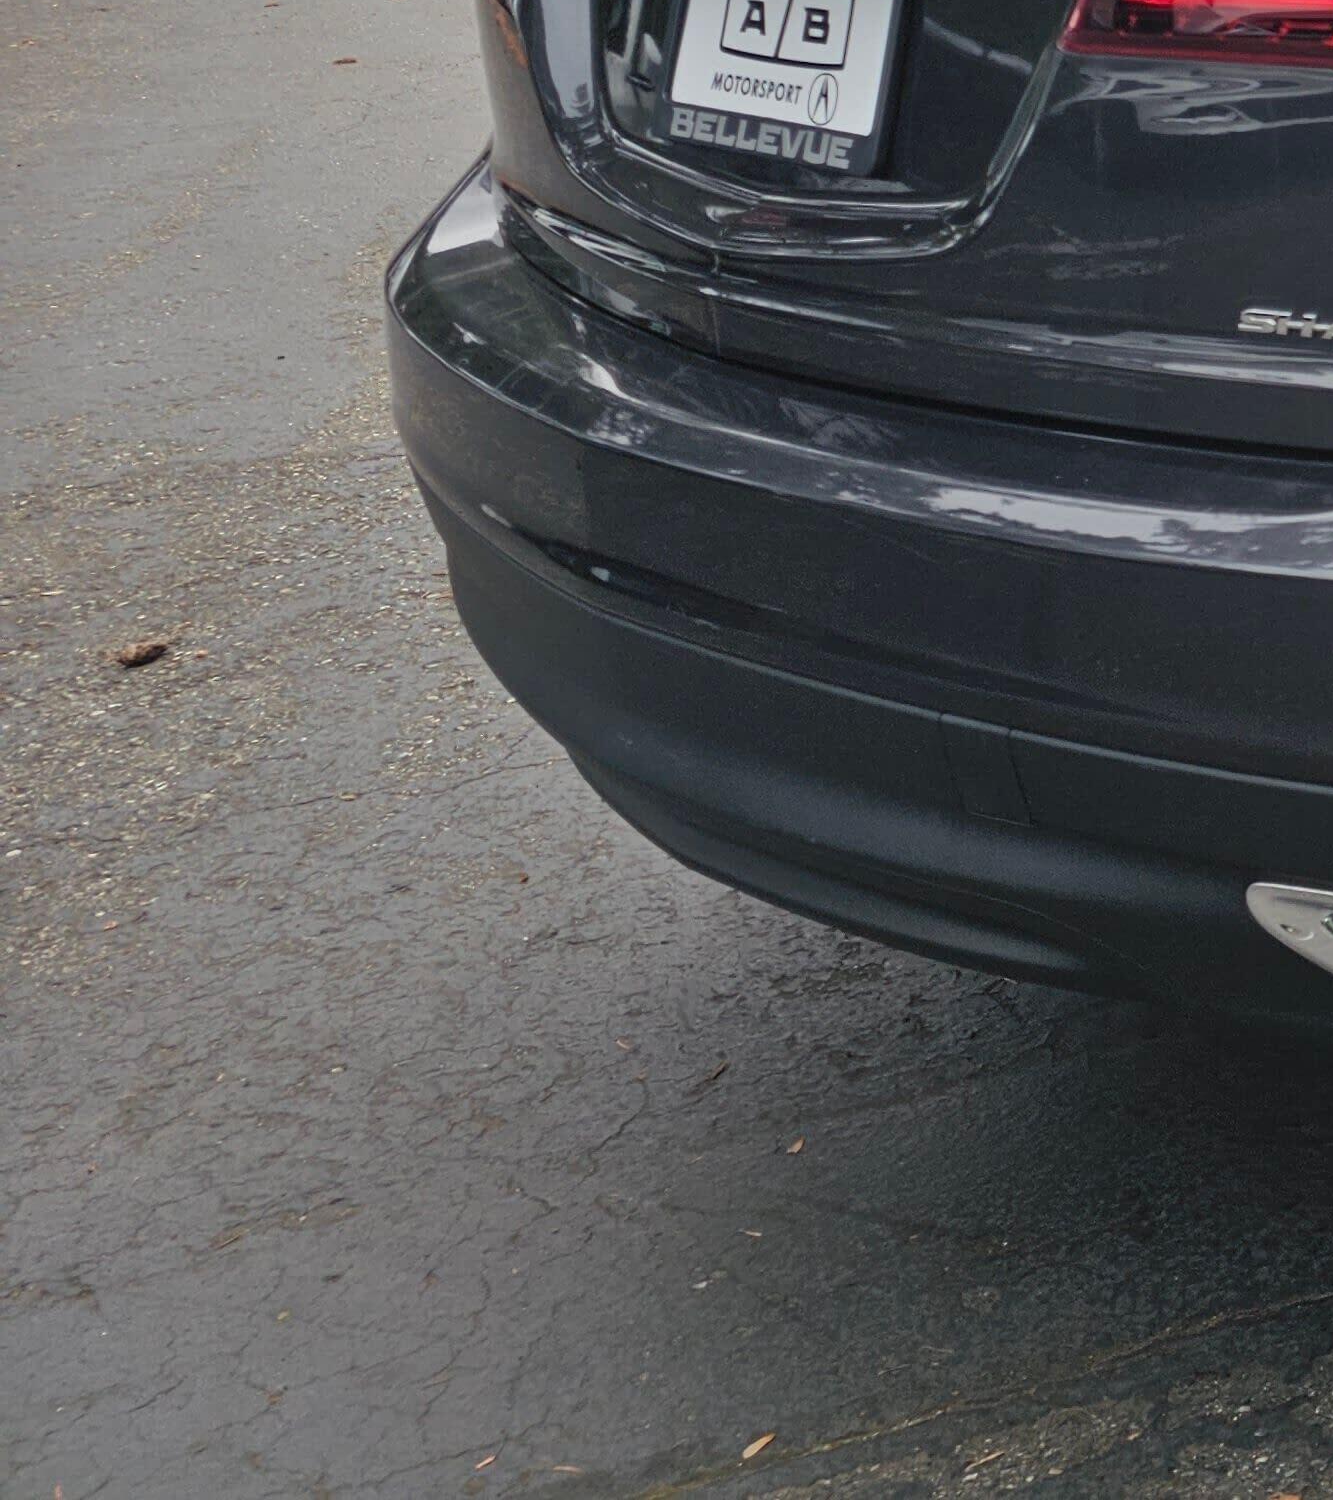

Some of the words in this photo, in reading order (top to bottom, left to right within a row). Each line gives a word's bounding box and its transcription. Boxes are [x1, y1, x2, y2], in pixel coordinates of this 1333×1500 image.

[739, 0, 767, 36] A
[802, 7, 831, 45] B
[711, 72, 803, 105] MOTORSPORT
[669, 107, 854, 170] BELLEVUE
